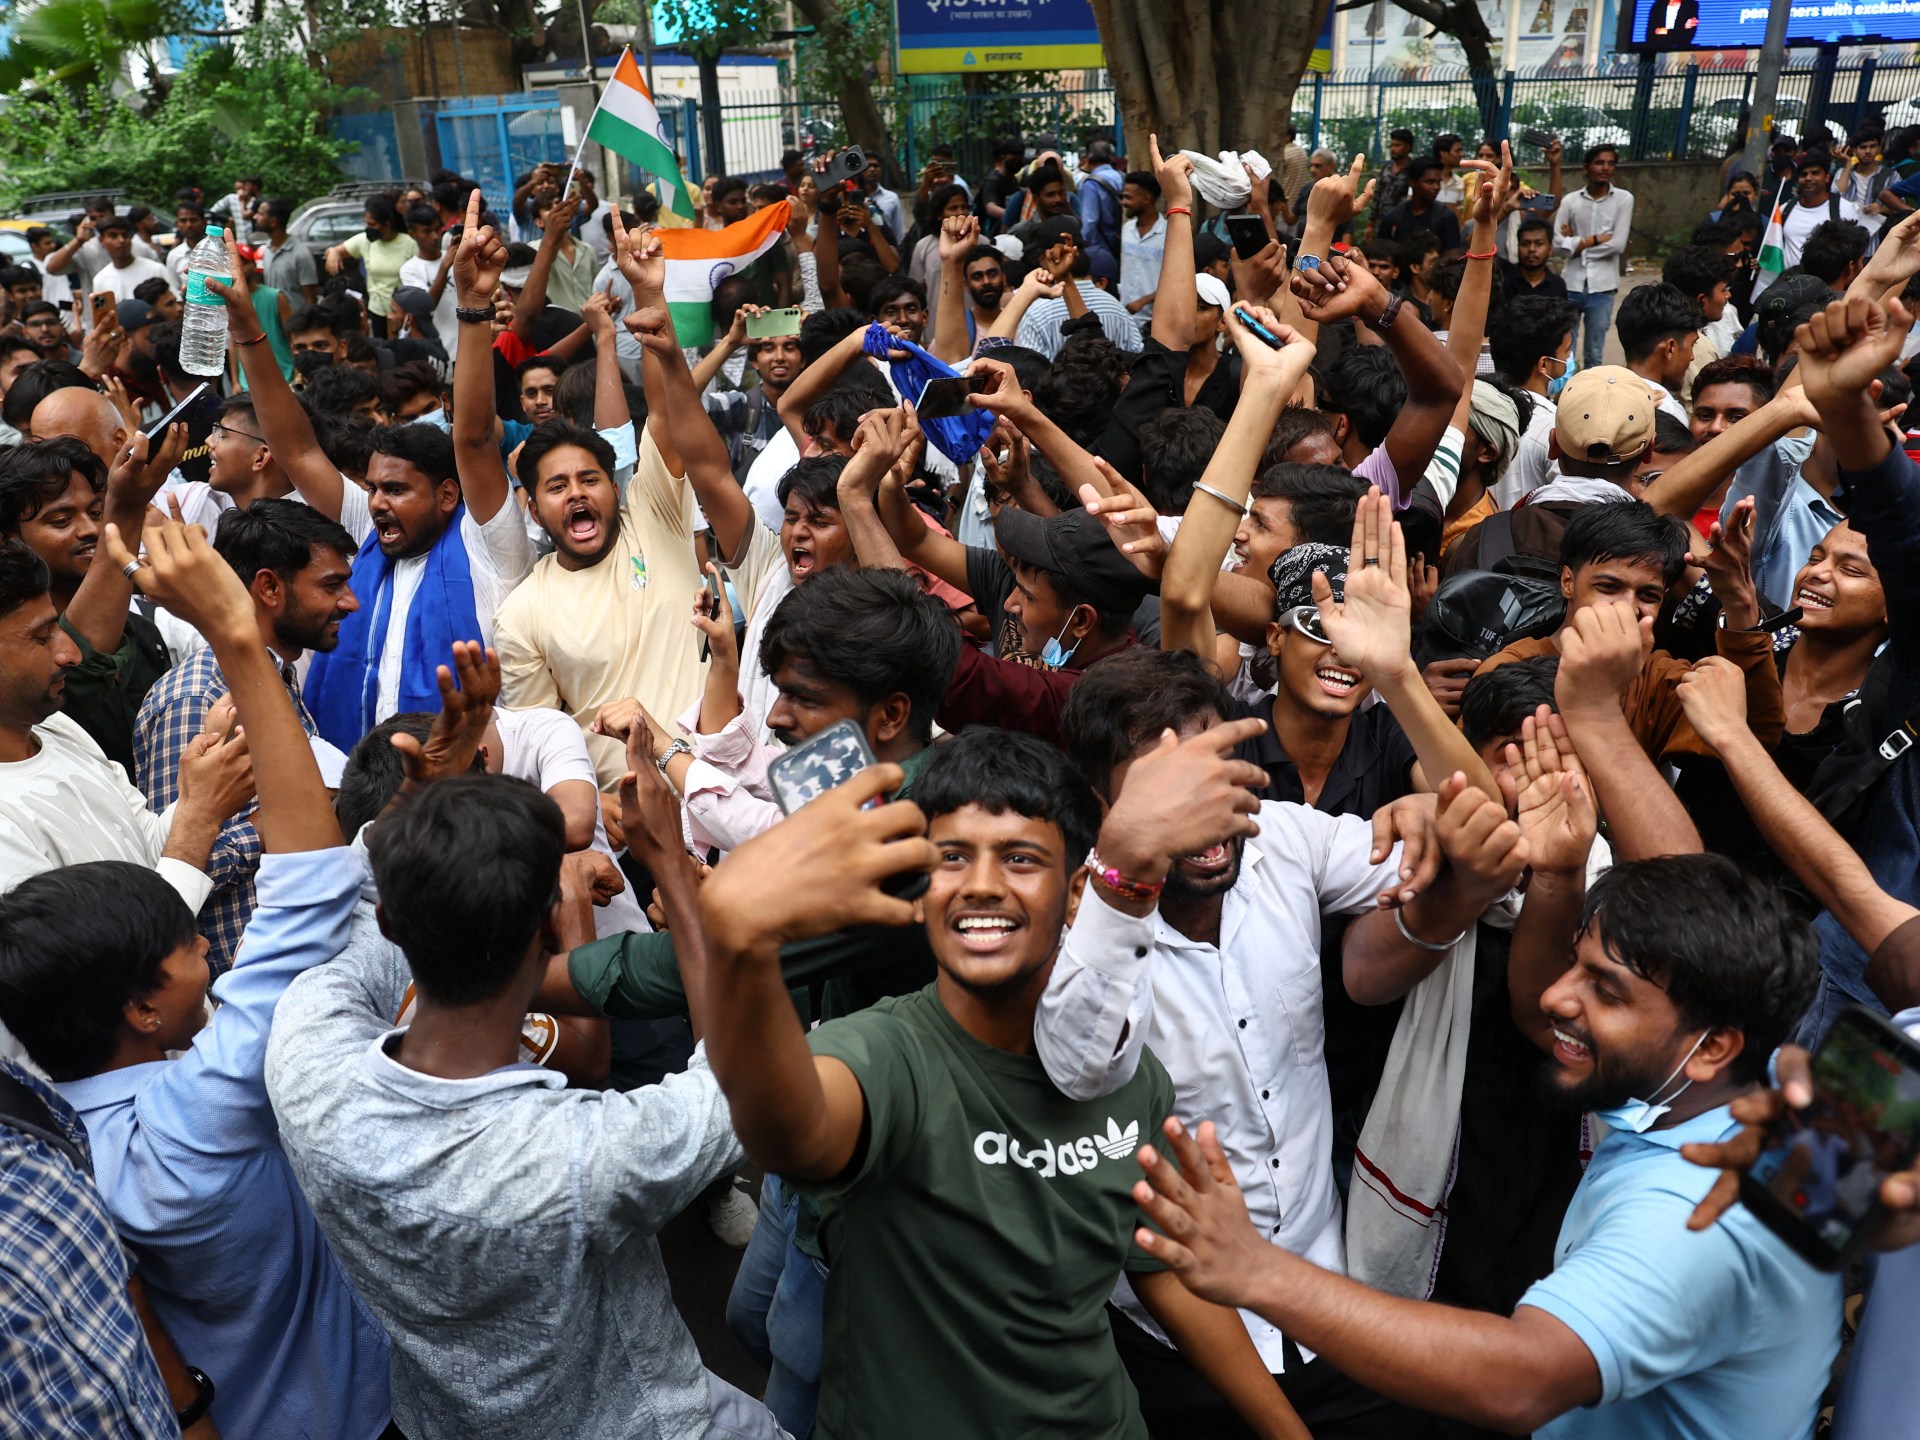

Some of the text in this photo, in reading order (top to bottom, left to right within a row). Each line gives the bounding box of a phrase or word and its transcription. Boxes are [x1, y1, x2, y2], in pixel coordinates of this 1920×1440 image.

[1739, 6, 1820, 24] penners
[1821, 2, 1853, 17] with
[1480, 627, 1496, 641] TUF
